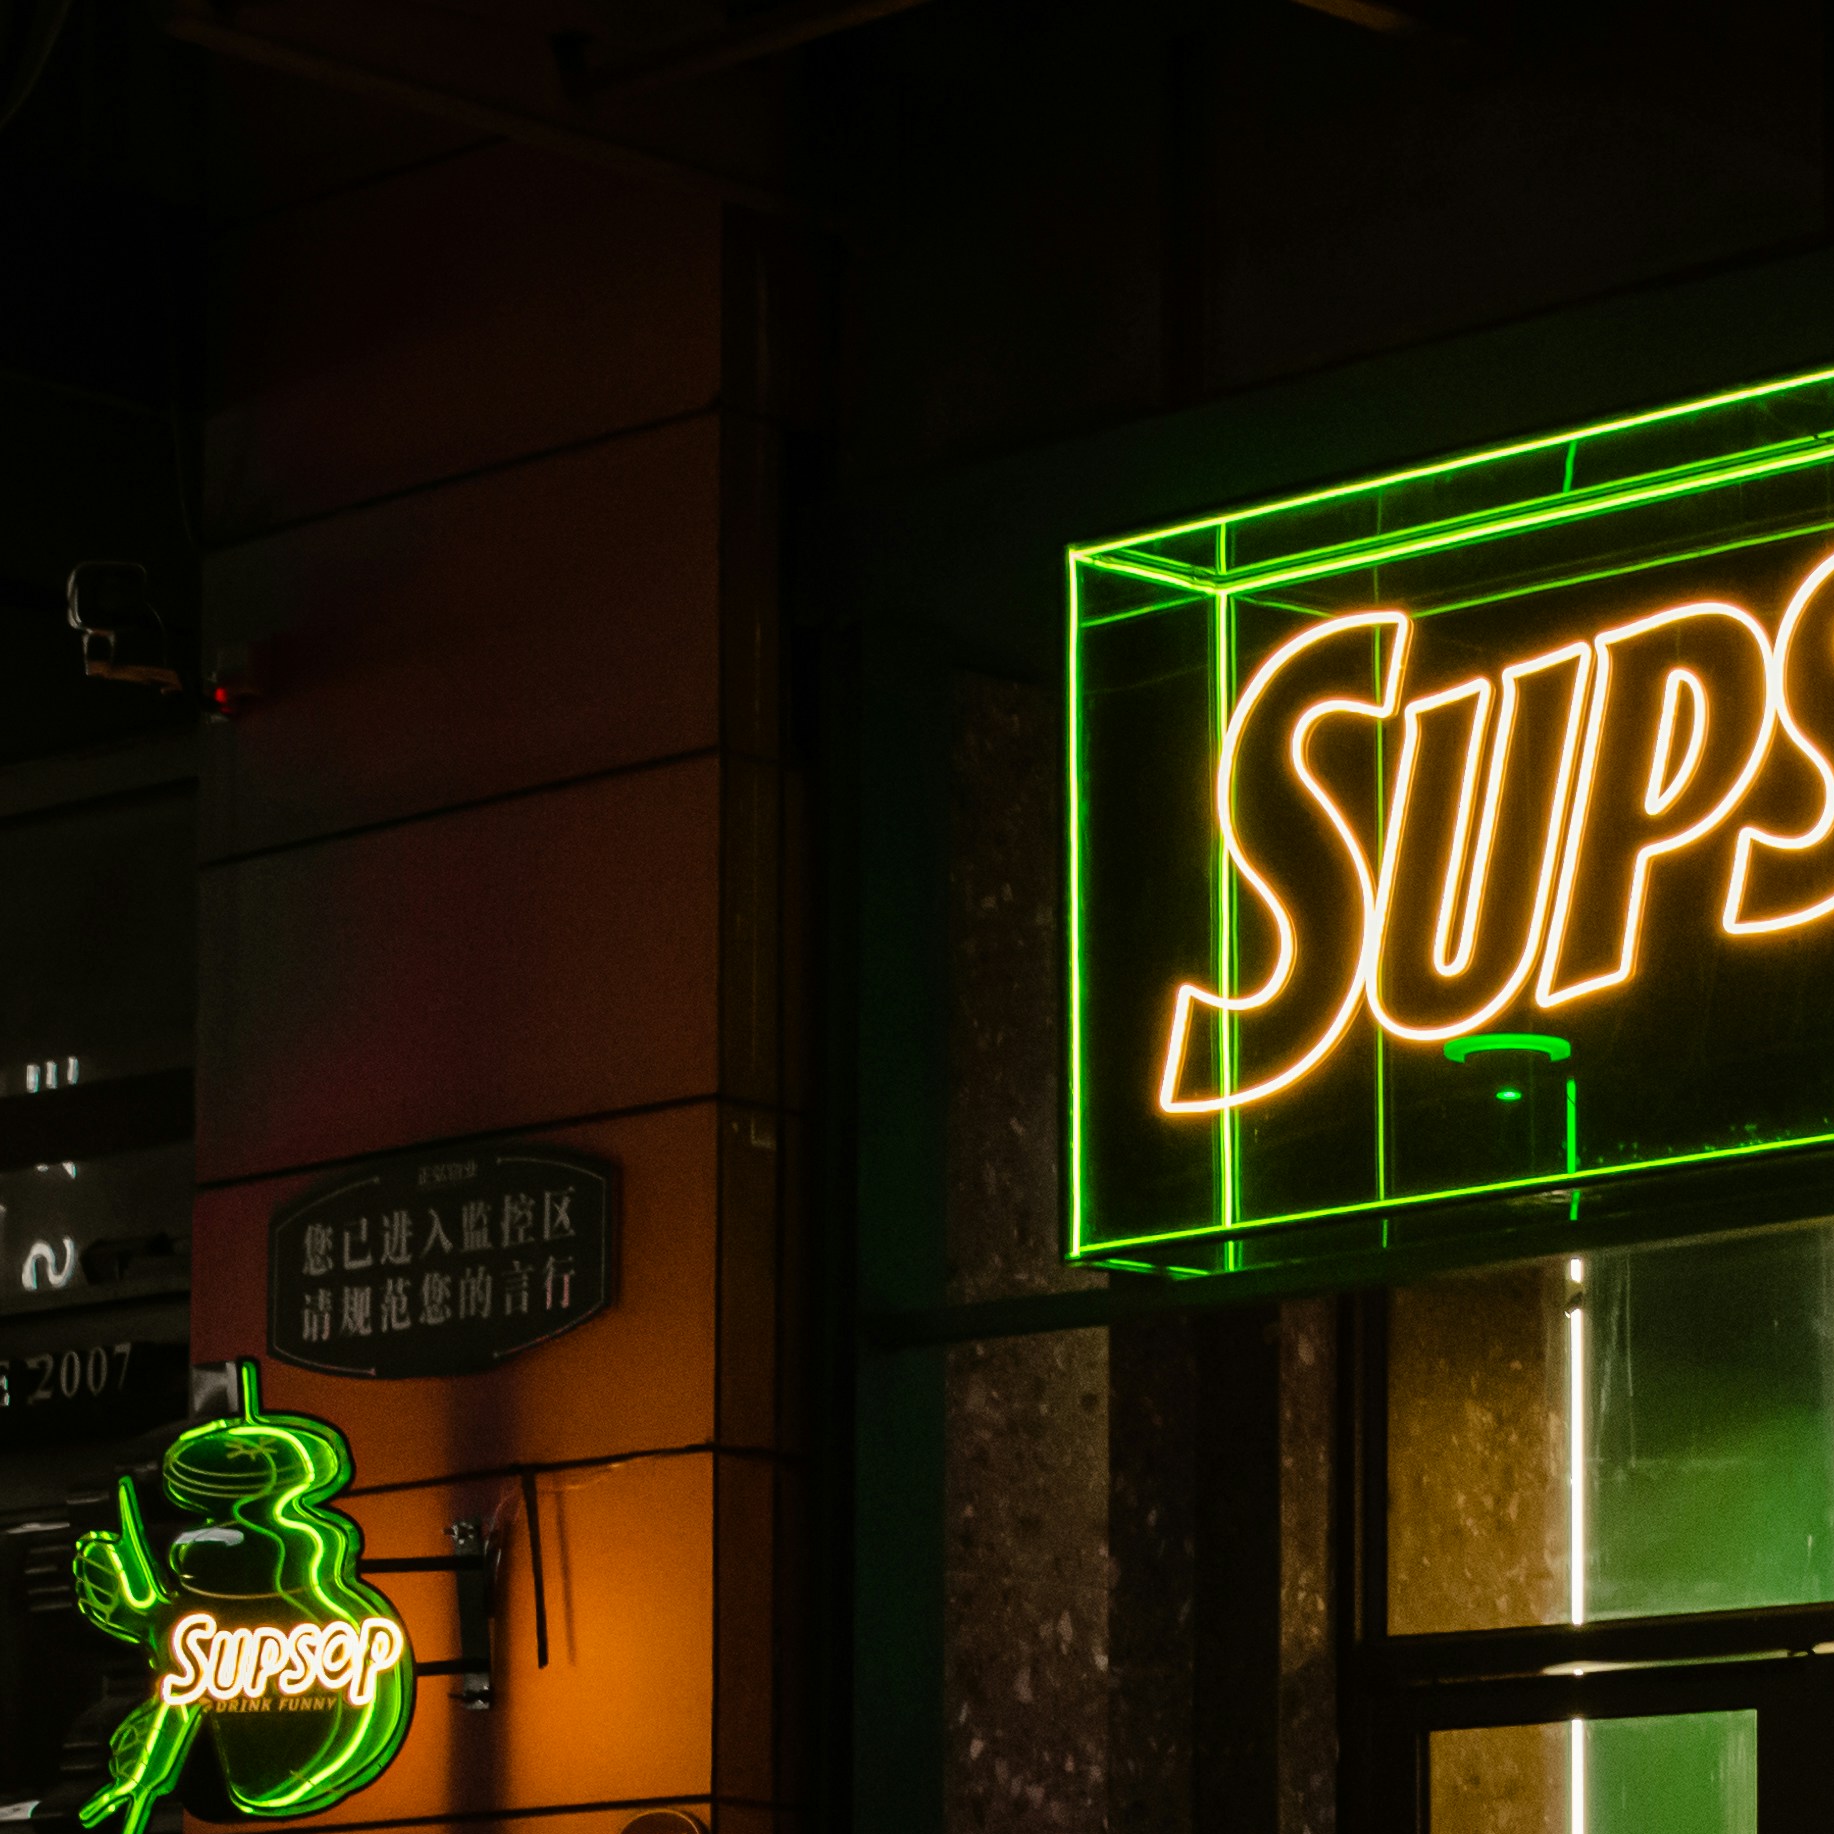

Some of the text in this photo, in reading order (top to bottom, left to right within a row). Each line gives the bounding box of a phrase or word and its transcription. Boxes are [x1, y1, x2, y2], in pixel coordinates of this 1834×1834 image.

[301, 1185, 577, 1277] 您已进入监控区
[300, 1254, 575, 1342] 请规范您的言行
[26, 1342, 131, 1404] 2007
[216, 1697, 336, 1713] DRINK FUNNY
